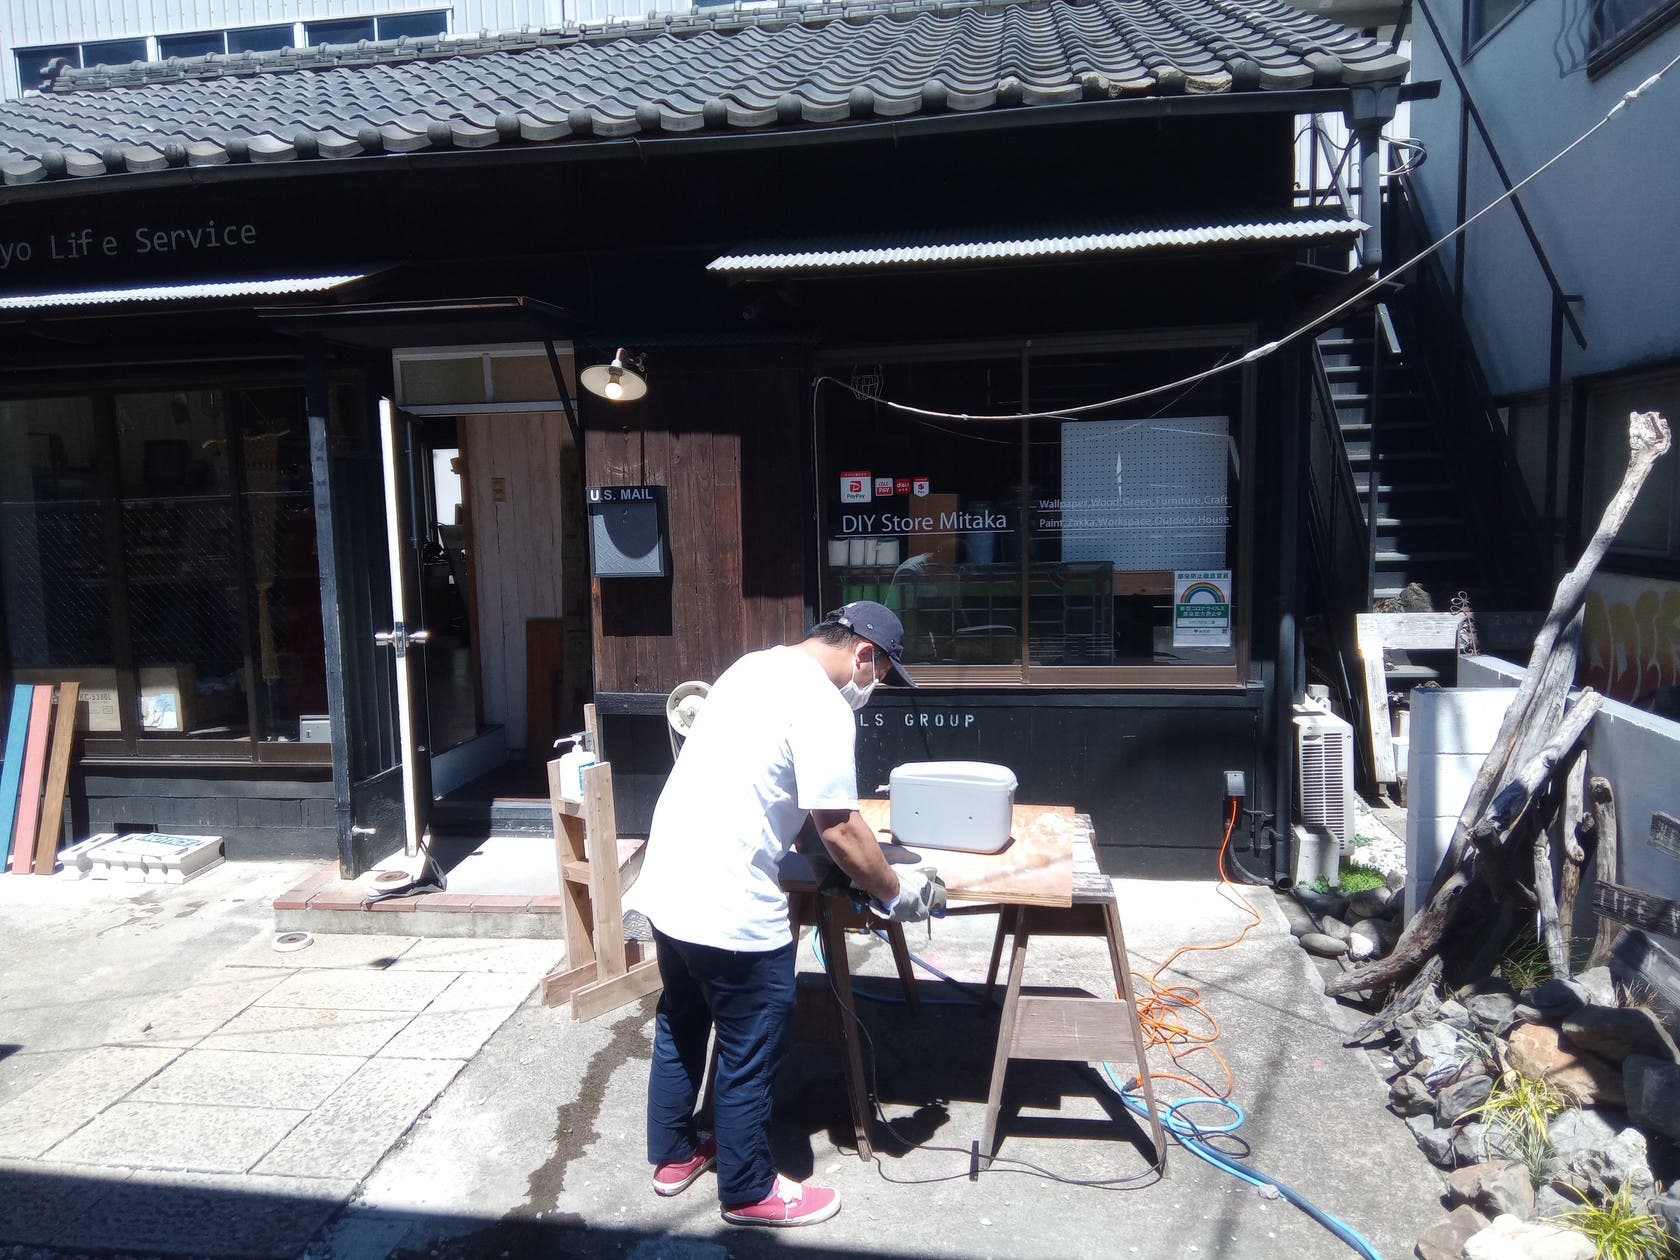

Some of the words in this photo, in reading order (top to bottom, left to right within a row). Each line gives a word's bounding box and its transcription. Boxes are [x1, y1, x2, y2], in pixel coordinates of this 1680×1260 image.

[51, 229, 118, 259] Life
[135, 220, 257, 253] Service
[590, 489, 617, 501] U.S.
[620, 488, 653, 500] MAIL
[842, 514, 876, 533] DIY
[881, 513, 933, 532] Store
[939, 509, 1007, 530] Mitaka
[904, 713, 975, 728] GROUP
